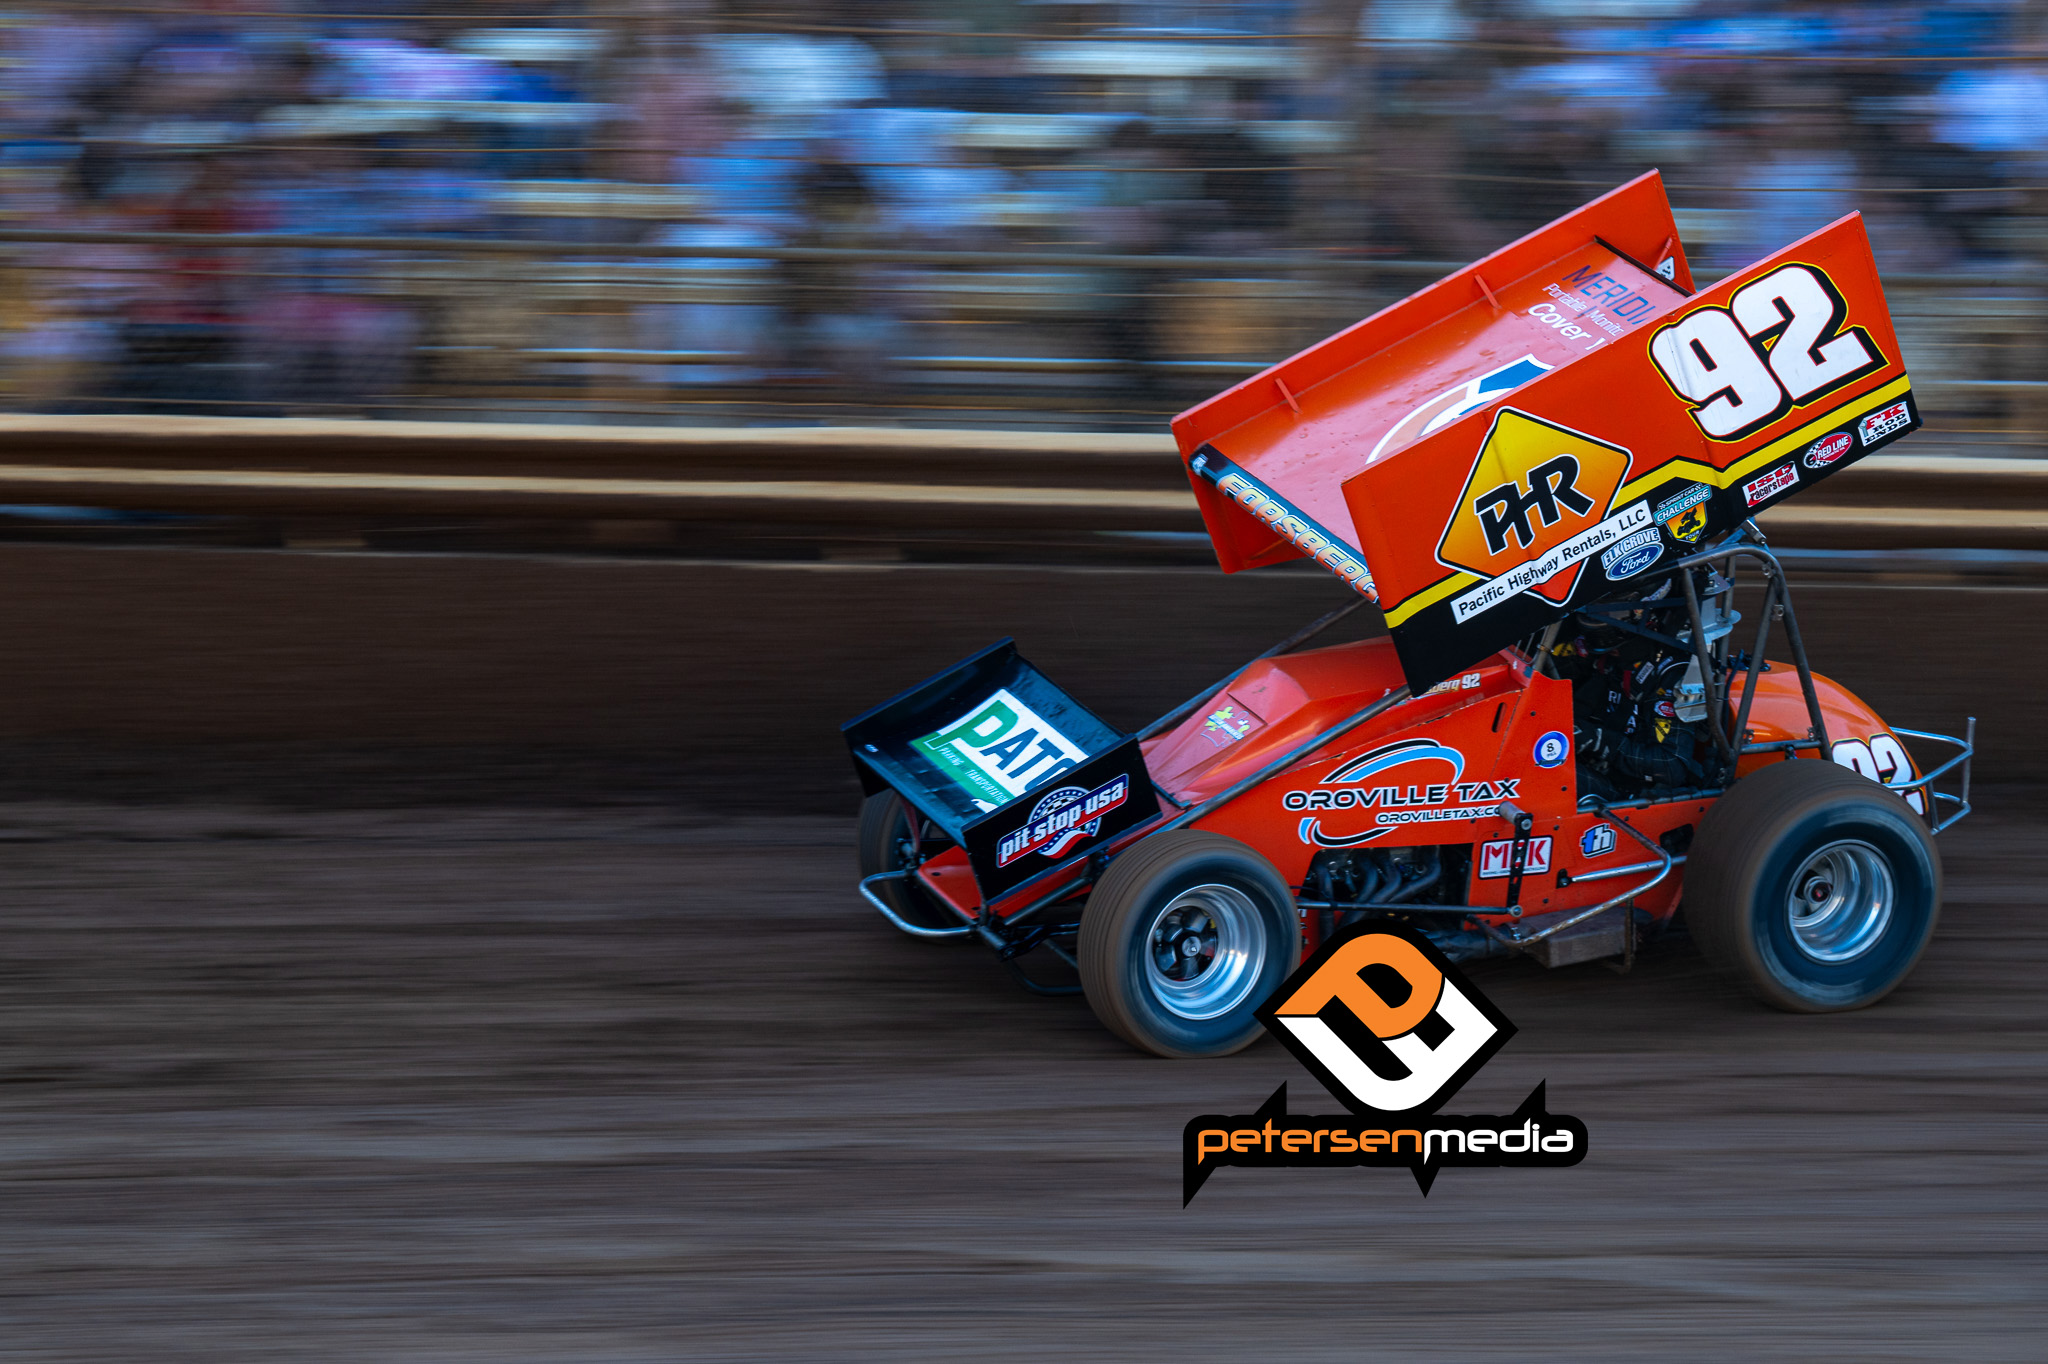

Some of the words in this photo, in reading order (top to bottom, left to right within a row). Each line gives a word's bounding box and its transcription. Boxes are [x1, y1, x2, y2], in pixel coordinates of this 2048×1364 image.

[1542, 283, 1588, 312] Portable
[1528, 303, 1592, 340] Cover
[1648, 262, 1889, 441] 92
[1865, 418, 1908, 444] ENDS
[1866, 402, 1905, 430] FK
[1873, 412, 1906, 433] ROD
[1817, 444, 1832, 460] RED
[1832, 435, 1849, 451] LINE
[1474, 454, 1595, 555] PHR
[1657, 488, 1709, 522] CHALLENGE
[1218, 473, 1379, 604] FORSBERG
[1603, 544, 1624, 567] ELK
[1623, 528, 1660, 552] GROVE
[1458, 584, 1506, 616] Pacific
[1507, 556, 1560, 589] Highway
[1562, 527, 1617, 561] Rentals,
[1619, 508, 1646, 531] LLC
[1620, 550, 1651, 573] Ford
[1461, 672, 1481, 689] 92
[1546, 742, 1555, 753] 8
[1283, 784, 1449, 810] OROVILLE
[1454, 779, 1520, 802] TAX
[1000, 829, 1031, 865] pit
[1033, 802, 1082, 844] stop
[1084, 781, 1126, 815] usa
[1483, 840, 1547, 870] MK
